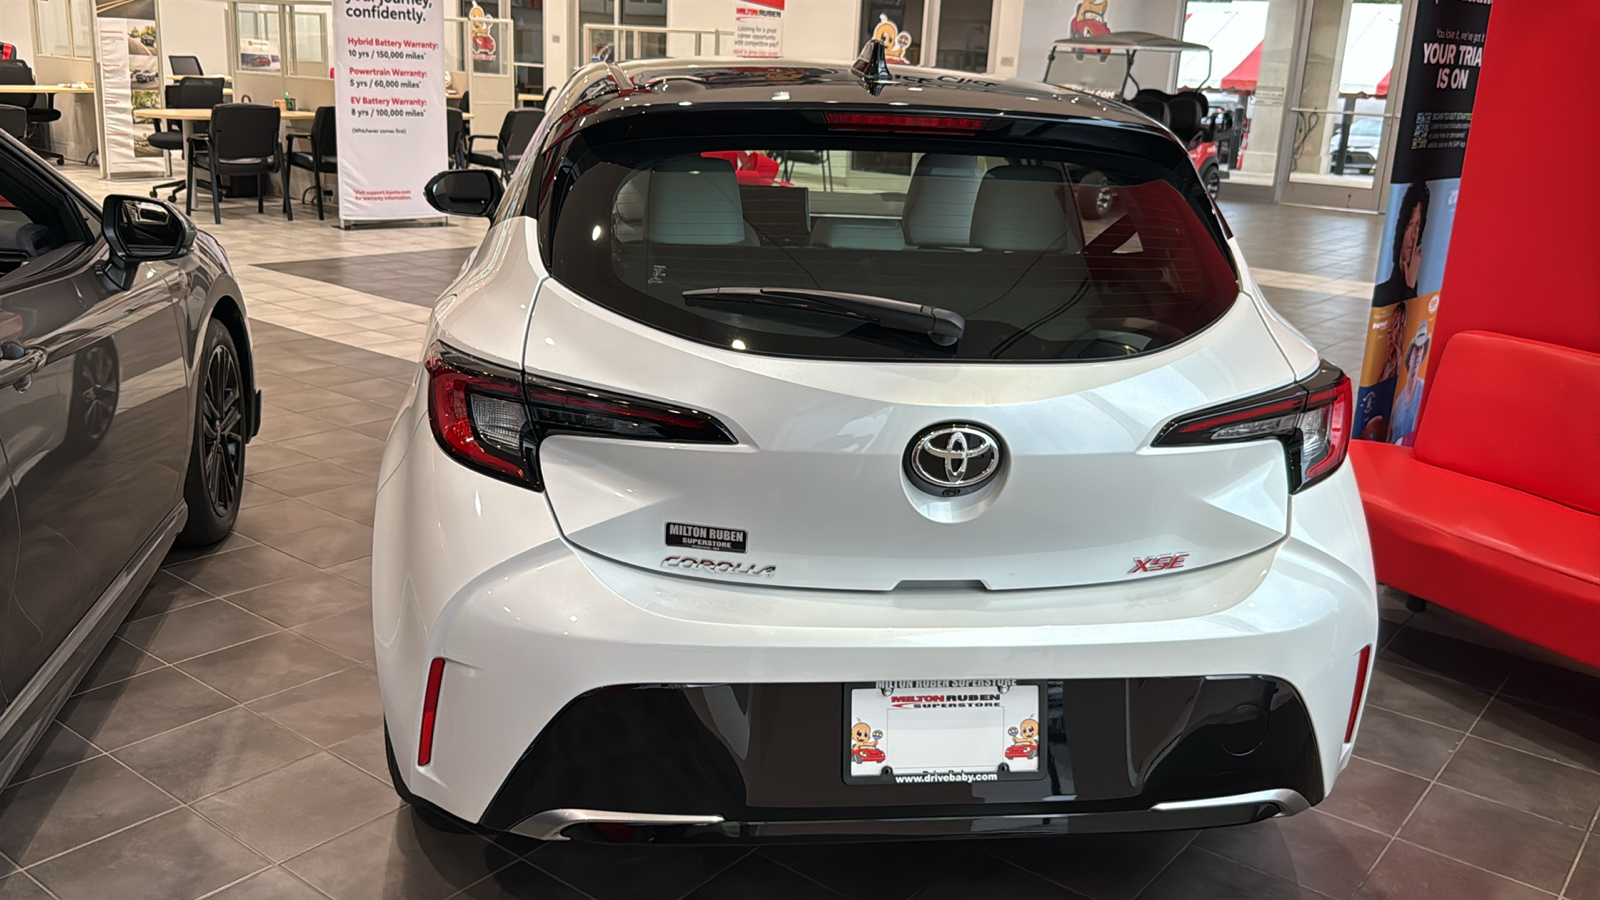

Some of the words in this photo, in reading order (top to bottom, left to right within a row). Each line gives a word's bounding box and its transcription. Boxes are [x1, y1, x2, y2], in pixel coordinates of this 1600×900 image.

[346, 6, 426, 24] confidently.
[759, 10, 781, 18] RUBEN
[347, 37, 374, 47] Hybrid
[375, 39, 402, 49] Battery
[403, 40, 438, 51] Warranty:
[358, 51, 370, 59] yrs
[371, 50, 375, 59] /
[376, 51, 404, 60] 150,000
[1423, 43, 1457, 65] YOUR
[1458, 45, 1483, 68] TRIA
[349, 67, 391, 76] Powertrain
[392, 69, 427, 79] Warranty:
[350, 79, 355, 87] 5
[356, 81, 368, 89] yrs
[369, 80, 373, 89] /
[374, 80, 399, 89] 60,000
[1436, 68, 1450, 89] IS
[1450, 68, 1469, 90] ON
[362, 97, 390, 106] Battery
[391, 98, 427, 107] Warranty:
[351, 108, 356, 116] 8
[358, 110, 369, 118] yrs
[370, 109, 374, 118] /
[376, 109, 404, 117] 100,000
[669, 524, 707, 538] MILTON
[709, 529, 743, 542] RUBEN
[682, 537, 732, 548] SUPERSTORE
[661, 555, 777, 577] COROLLA
[1127, 551, 1190, 573] XSE
[876, 680, 912, 689] MILTON
[915, 680, 949, 688] RUBEN
[951, 679, 1017, 687] SUPERSTORE
[895, 772, 998, 783] www.drivebaby.com
